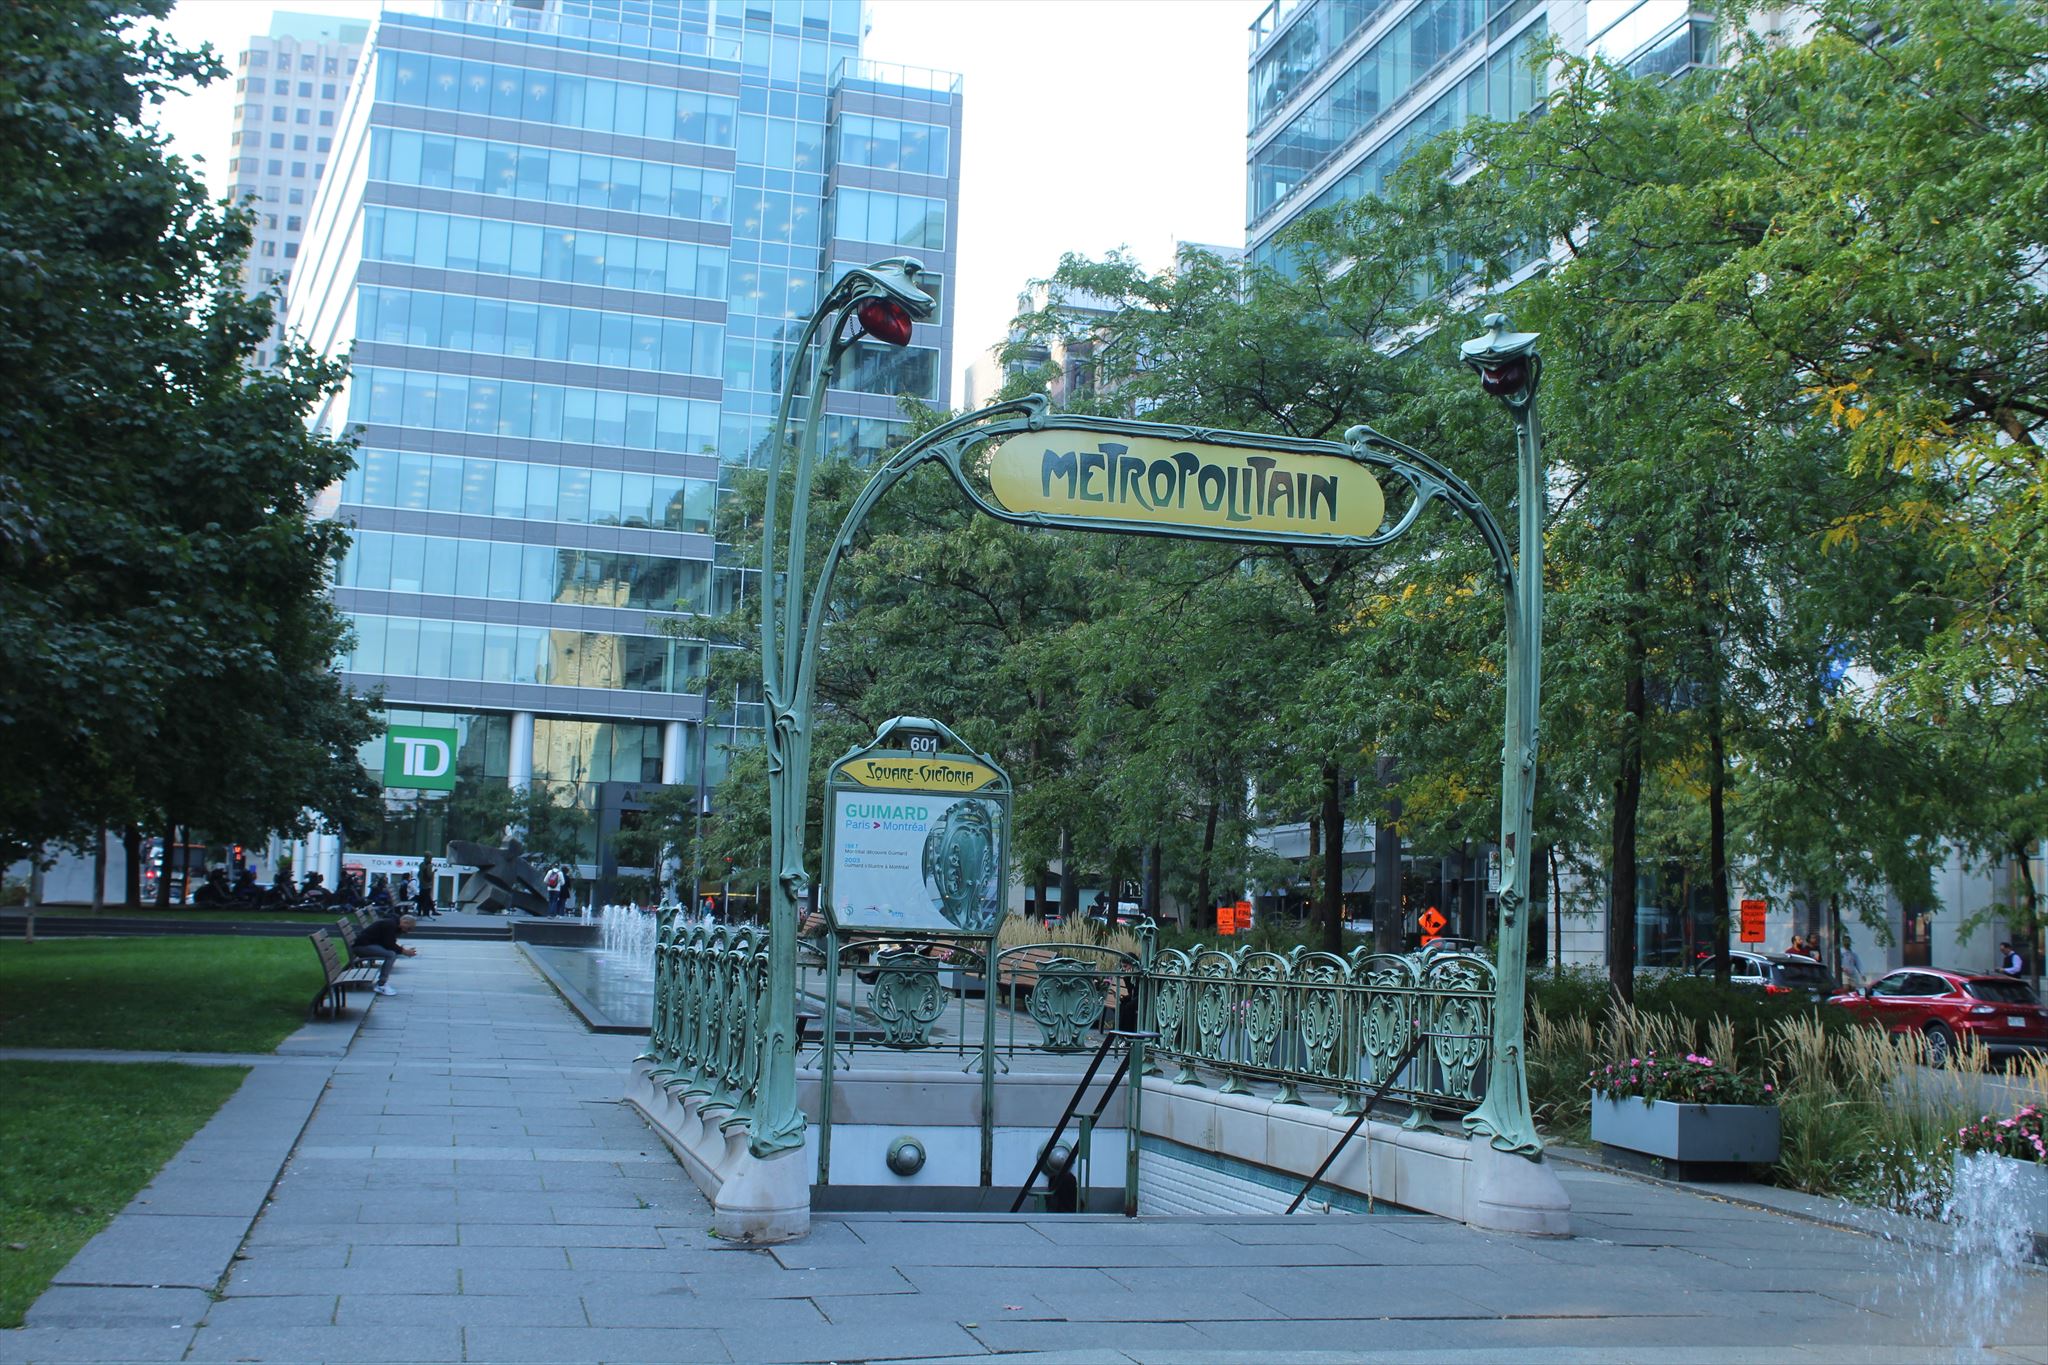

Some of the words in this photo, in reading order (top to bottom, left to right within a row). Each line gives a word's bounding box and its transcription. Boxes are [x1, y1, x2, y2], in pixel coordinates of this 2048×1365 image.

[1042, 442, 1338, 522] METROPOLITAIN
[910, 737, 937, 752] 601
[393, 736, 449, 777] TD
[845, 804, 928, 821] GUIMARD
[845, 820, 871, 830] Paris
[883, 821, 928, 832] Montréal
